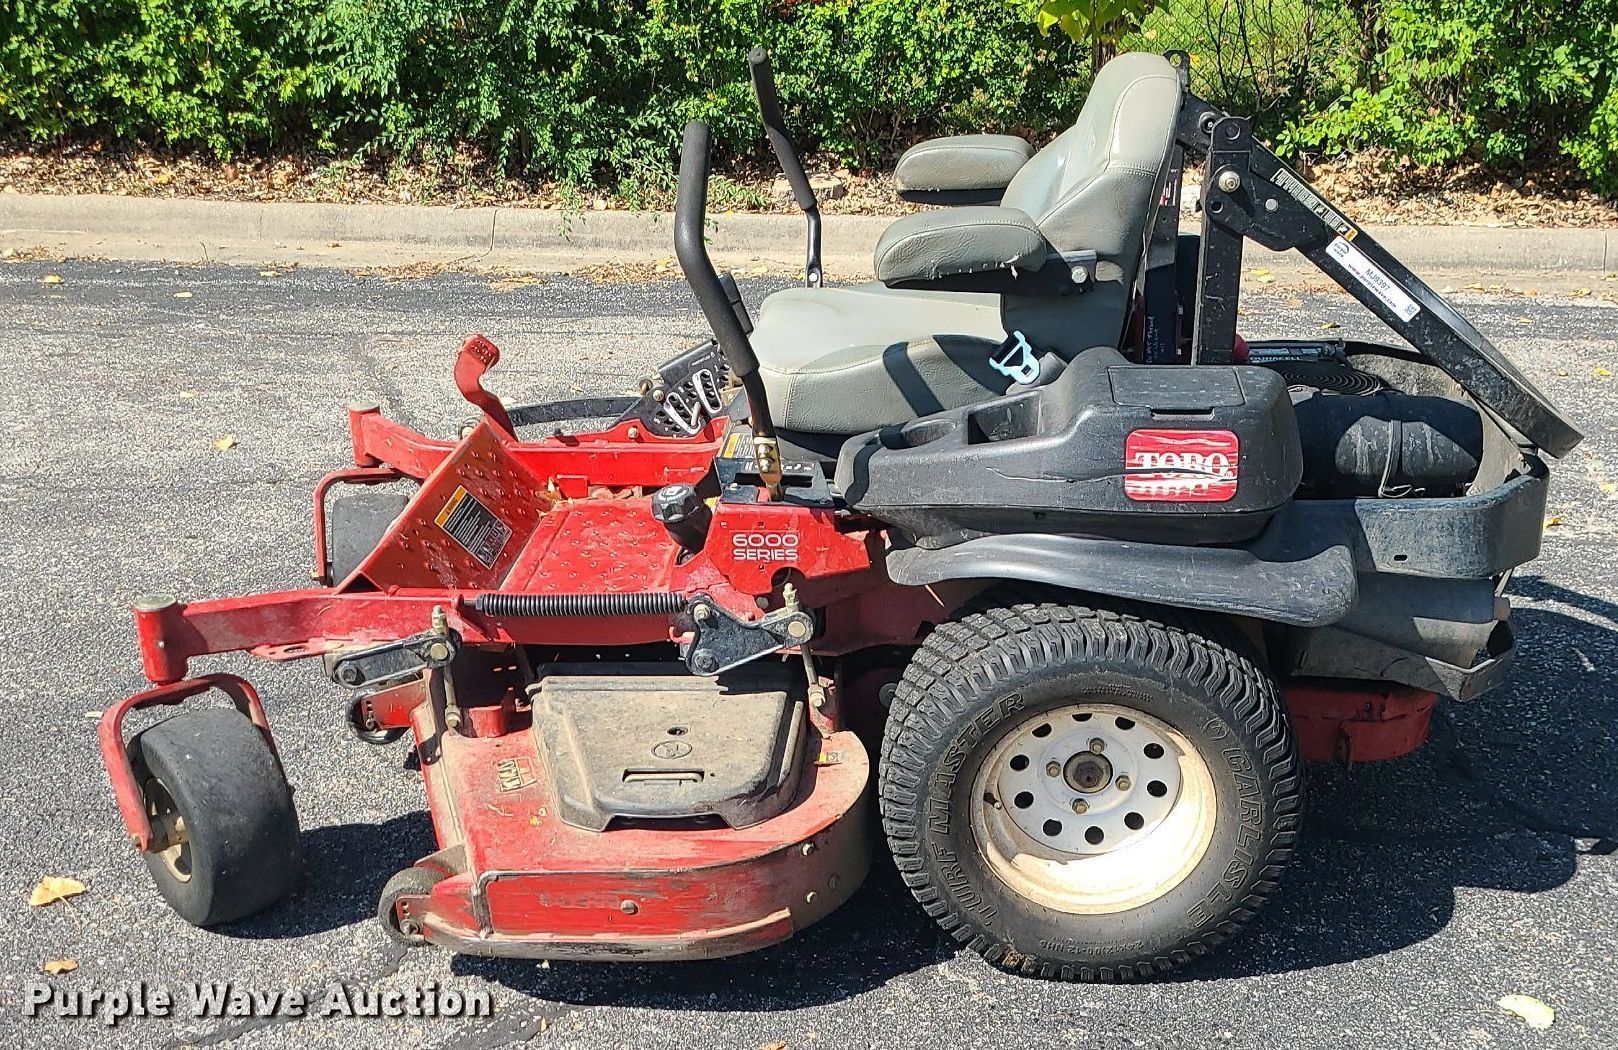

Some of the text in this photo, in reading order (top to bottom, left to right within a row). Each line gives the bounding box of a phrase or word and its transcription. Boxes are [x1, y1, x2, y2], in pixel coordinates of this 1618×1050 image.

[1348, 264, 1397, 308] www.purplewave.com
[732, 533, 799, 547] 6000
[732, 548, 799, 562] SERIES
[928, 692, 1025, 927] TURF MASTER
[1186, 746, 1262, 927] CARLISLE
